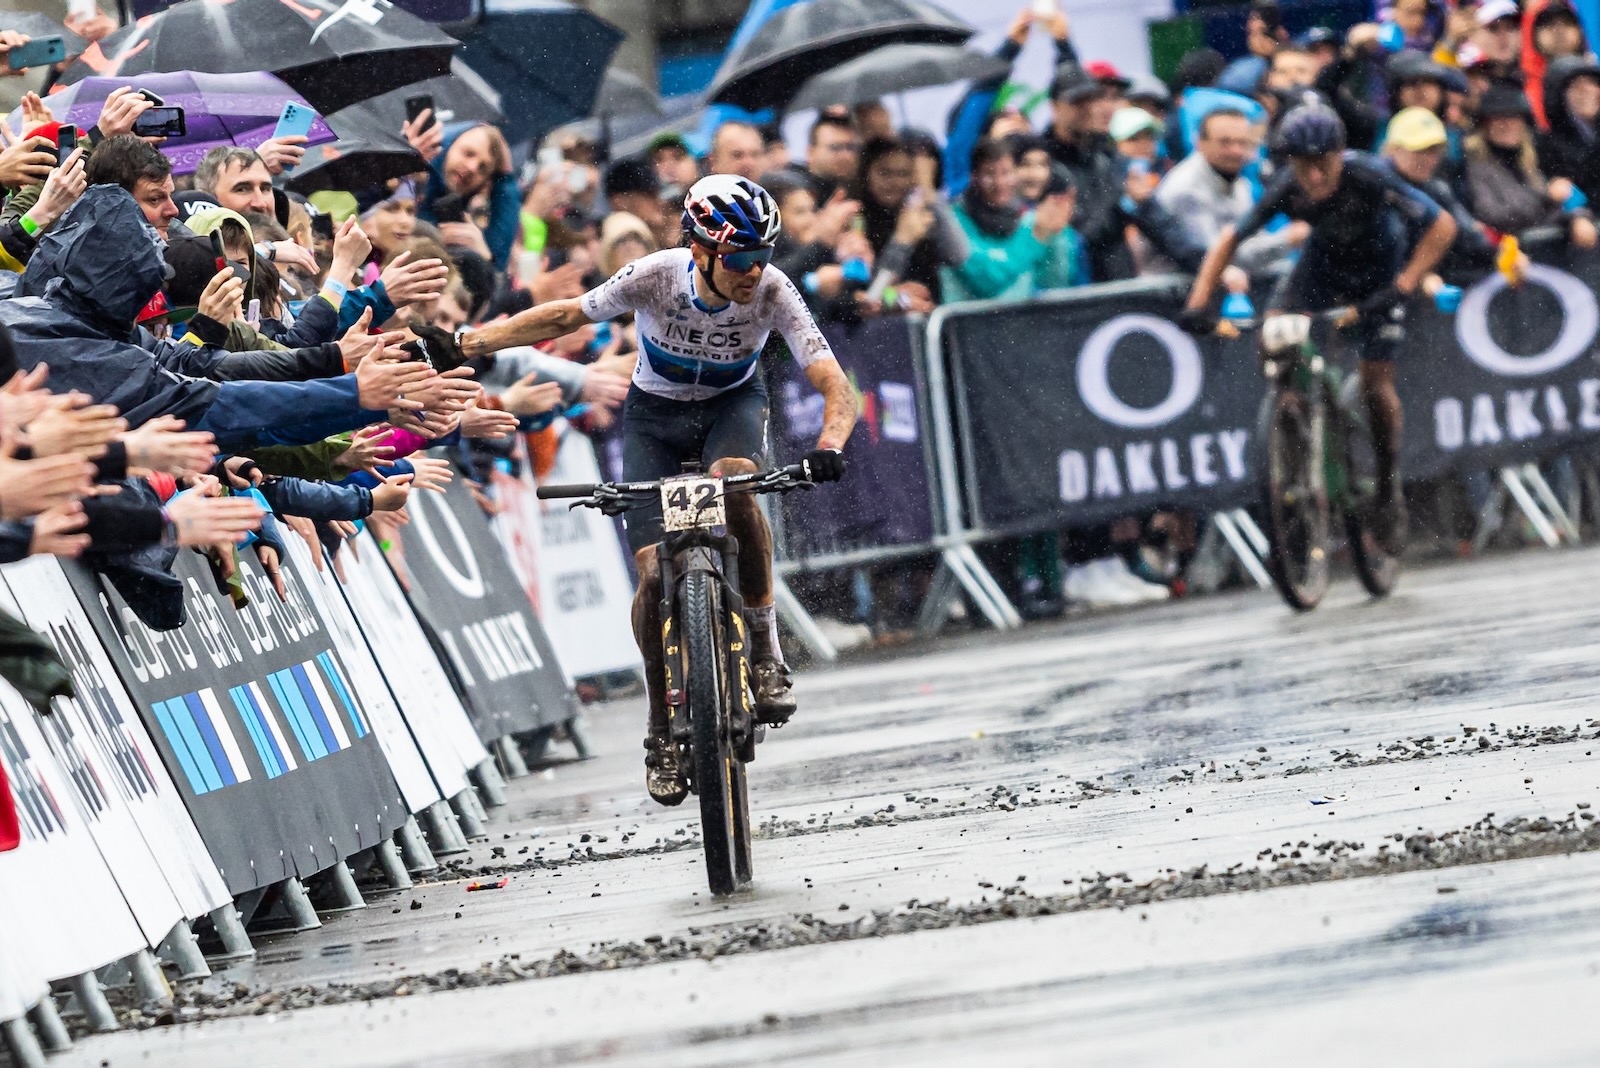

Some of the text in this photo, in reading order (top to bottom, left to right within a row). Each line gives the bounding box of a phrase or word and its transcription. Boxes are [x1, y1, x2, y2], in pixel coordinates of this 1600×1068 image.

[666, 323, 741, 348] INEOS
[1058, 428, 1248, 502] OAKLEY
[668, 484, 718, 511] 42
